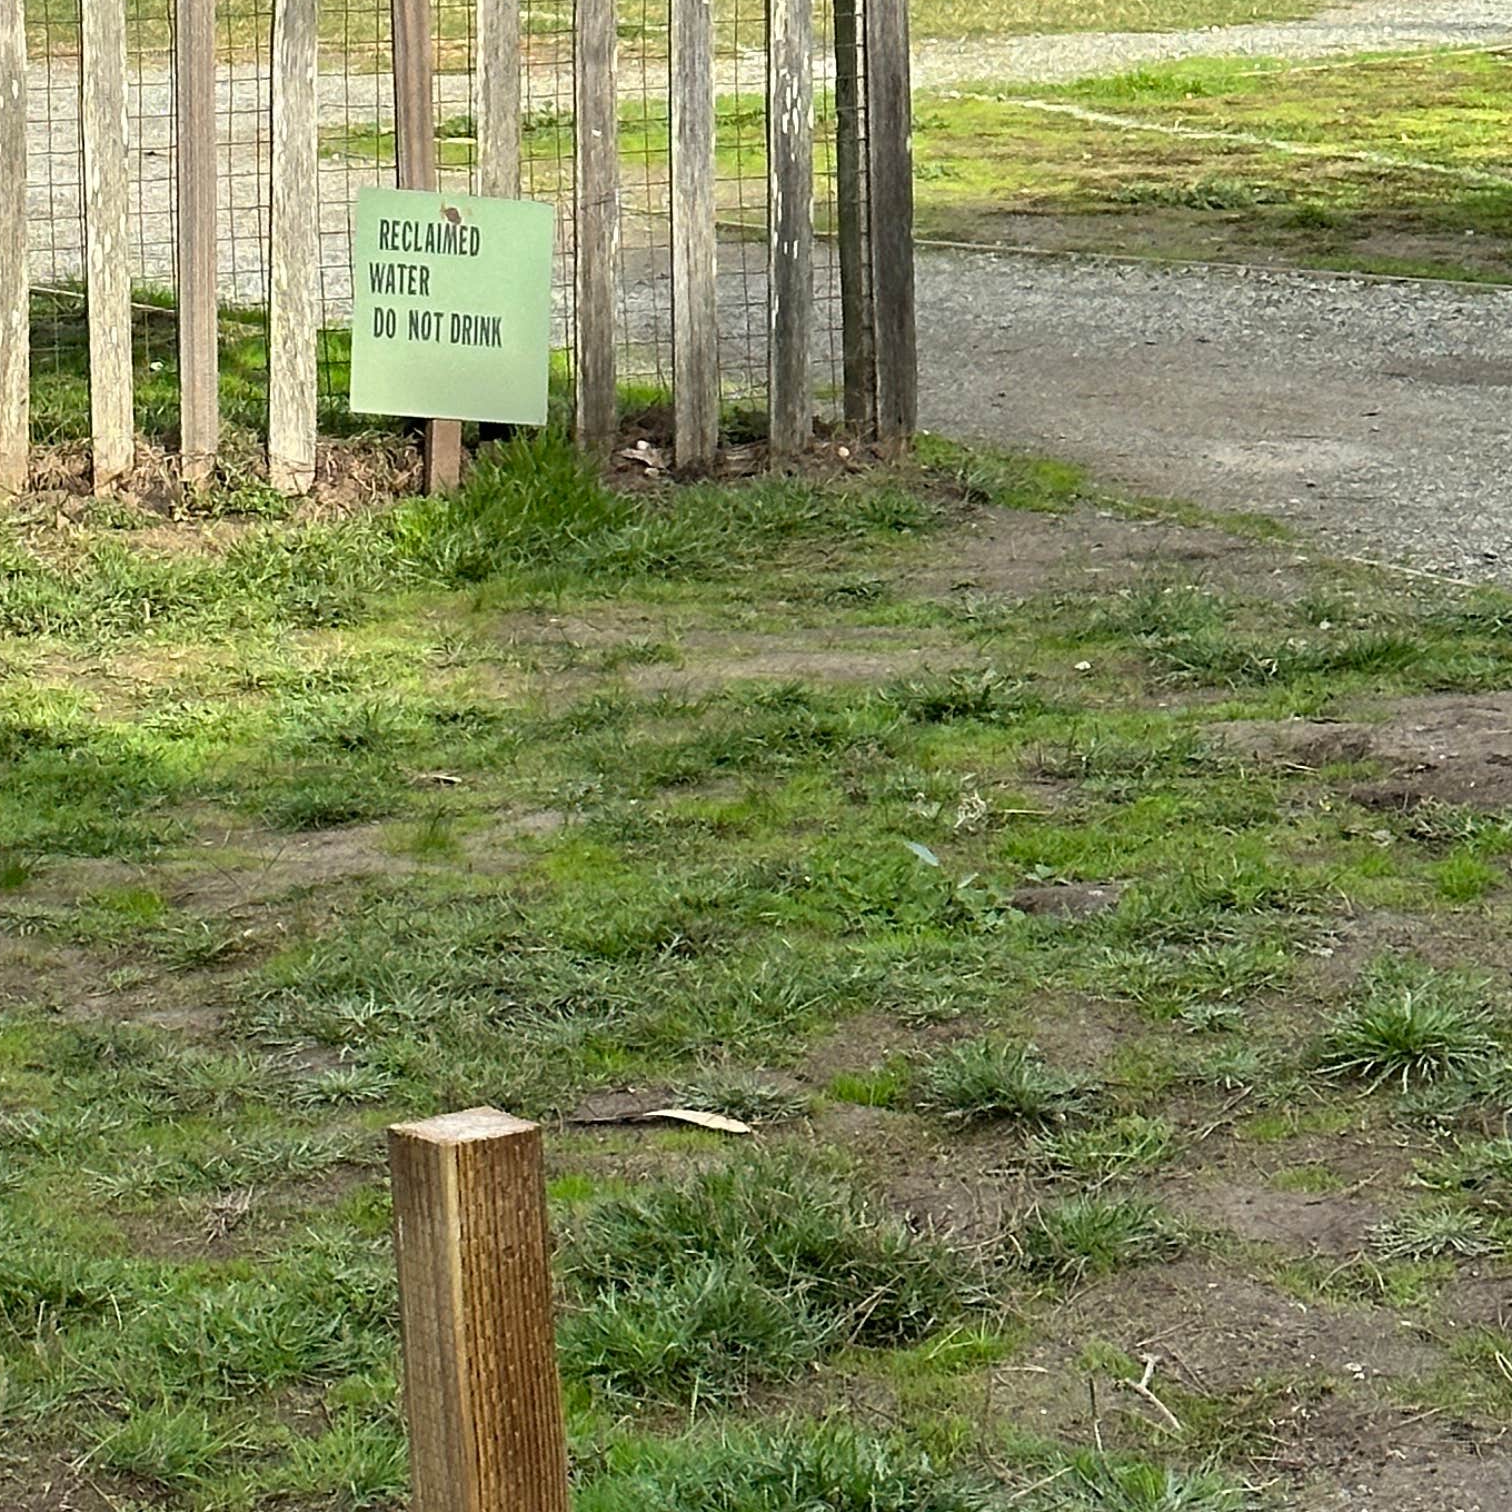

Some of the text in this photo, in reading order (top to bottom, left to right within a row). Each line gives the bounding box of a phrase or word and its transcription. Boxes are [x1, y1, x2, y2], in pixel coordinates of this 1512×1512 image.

[379, 219, 480, 256] RECLAIMED
[369, 262, 430, 296] WATER
[373, 307, 502, 347] DO NOT DRINK
